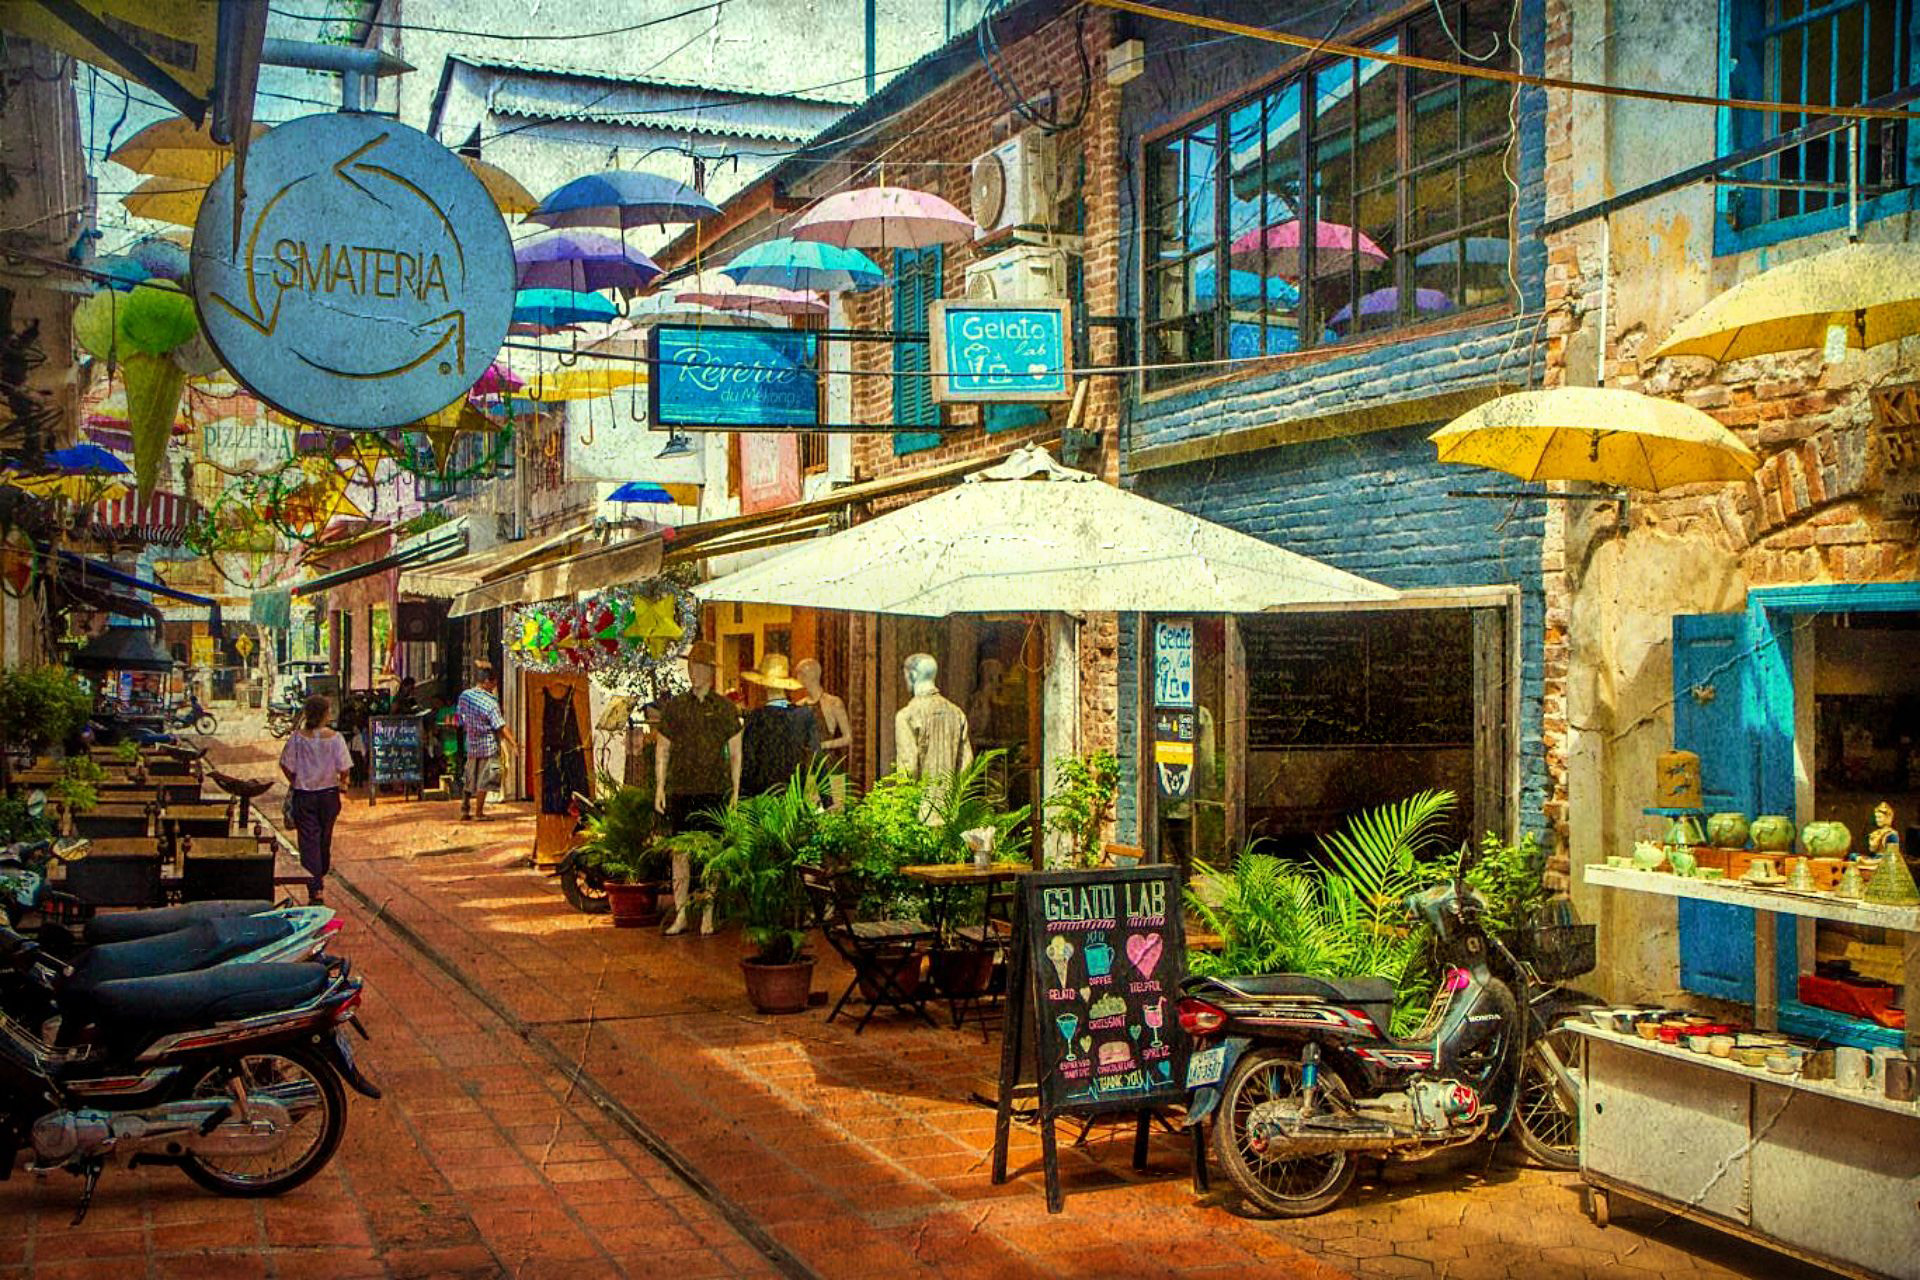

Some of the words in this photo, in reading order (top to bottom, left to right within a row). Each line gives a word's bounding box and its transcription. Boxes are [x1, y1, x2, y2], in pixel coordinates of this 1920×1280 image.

[272, 238, 450, 303] SMATERIA
[963, 316, 1045, 340] Gelato
[204, 426, 292, 460] PIZZERIA
[1044, 884, 1115, 920] GELATO
[1125, 880, 1166, 917] LAB
[1469, 1013, 1502, 1022] HONDA
[1125, 1070, 1145, 1088] YOU
